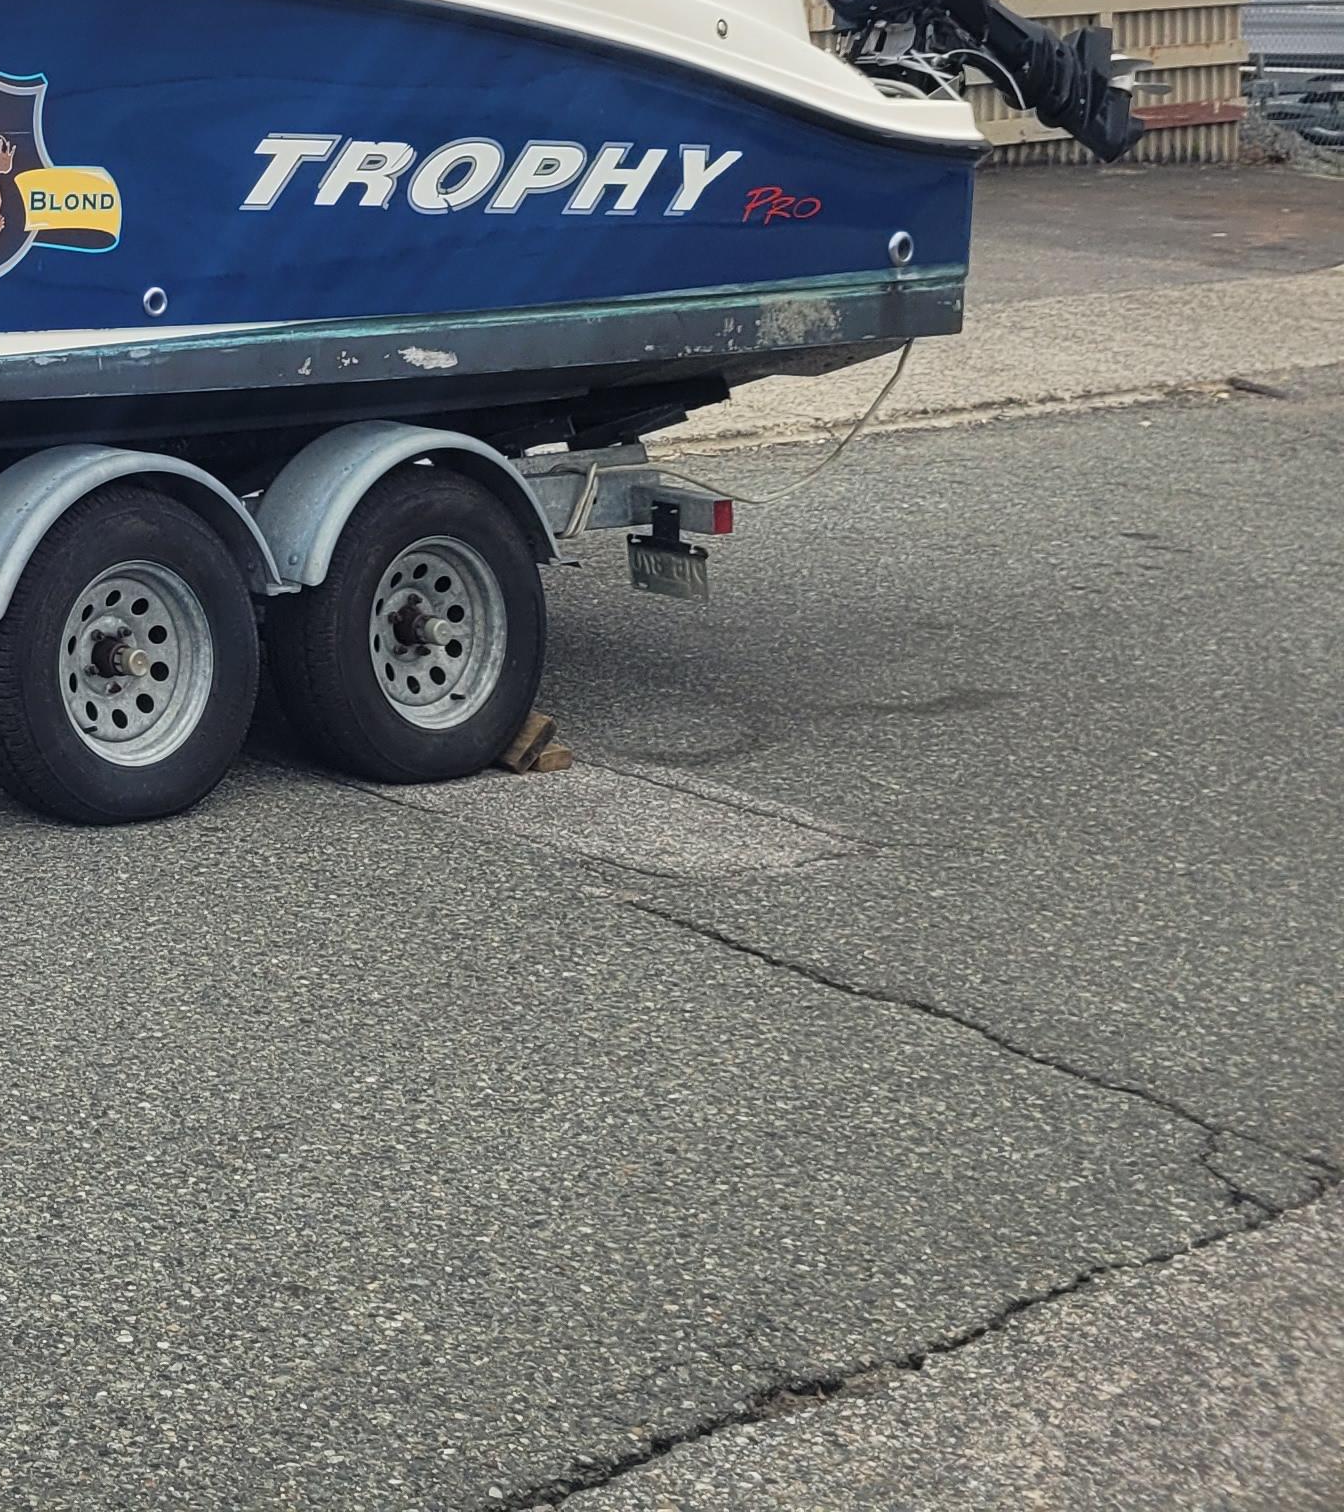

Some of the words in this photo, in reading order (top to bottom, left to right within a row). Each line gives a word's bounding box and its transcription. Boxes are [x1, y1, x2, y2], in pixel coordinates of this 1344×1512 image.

[28, 190, 115, 212] BLOND
[238, 132, 742, 216] TROPHY
[741, 185, 822, 224] PRO
